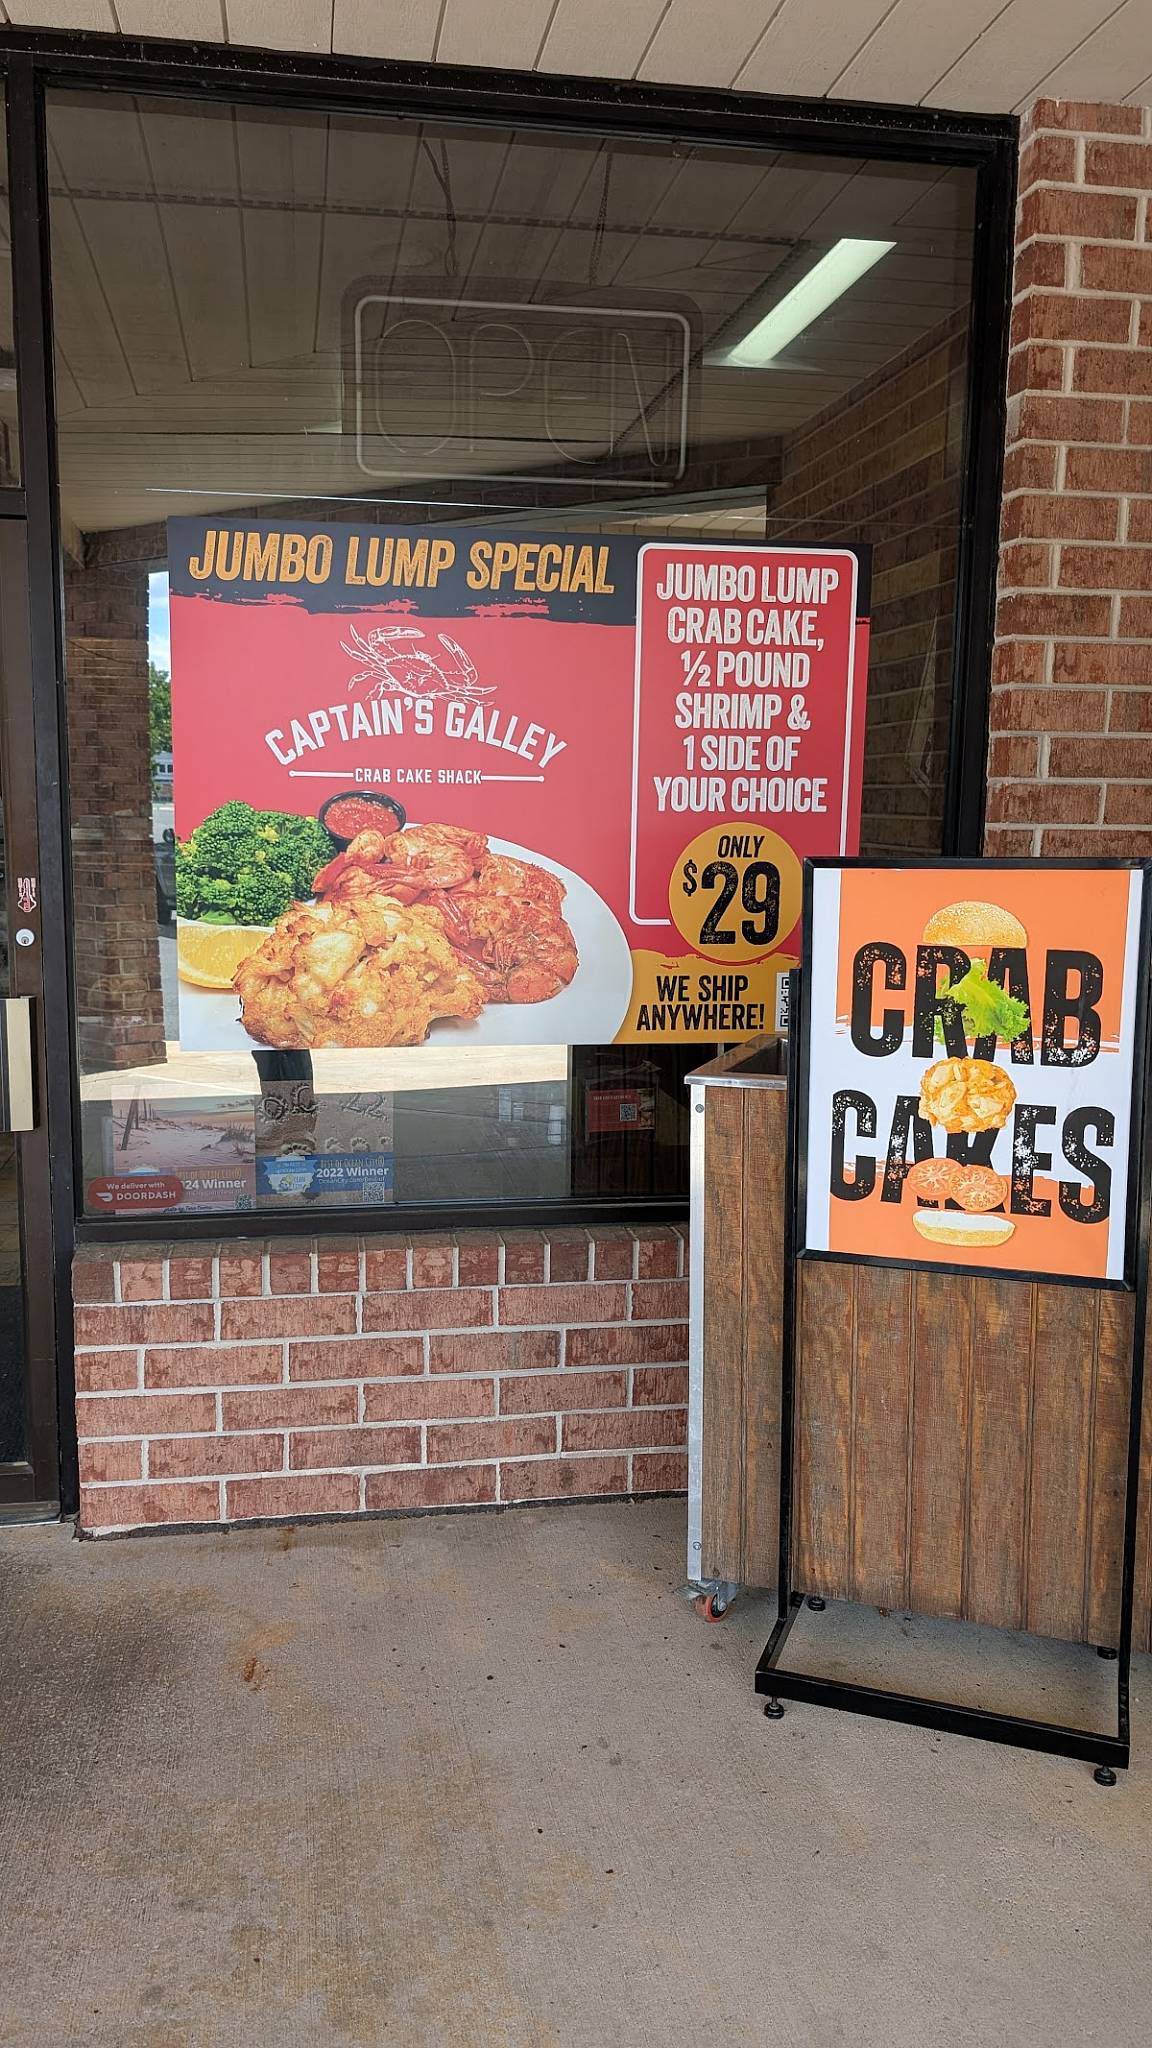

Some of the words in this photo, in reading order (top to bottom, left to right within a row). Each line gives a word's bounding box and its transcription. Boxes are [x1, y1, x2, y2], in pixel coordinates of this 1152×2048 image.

[188, 530, 333, 584] JUMBO
[345, 536, 456, 588] LUMP
[466, 541, 615, 594] SPECIAL
[656, 563, 756, 602] JUMBO
[761, 566, 839, 604] LUMP
[667, 607, 742, 644] CRAB
[746, 608, 825, 652] CAKE,
[716, 651, 811, 688] POUND
[674, 692, 782, 729] SHRIMP
[787, 694, 811, 730] &
[264, 697, 434, 766] CAPTAIN'S
[445, 702, 568, 769] GALLEY
[682, 735, 695, 771] 1
[700, 735, 761, 771] SIDE
[766, 736, 801, 771] OF
[354, 767, 391, 783] CRAB
[397, 768, 432, 784] CAKE
[438, 769, 482, 785] SHACK
[653, 776, 727, 812] YOUR
[731, 777, 828, 813] CHOICE
[717, 835, 765, 858] ONLY
[682, 859, 781, 946] $29
[656, 975, 690, 1002] WE
[698, 975, 749, 1002] SHIP
[850, 941, 1104, 1068] CRAB
[636, 1003, 765, 1031] ANYWHERE!
[120, 1182, 147, 1190] deliver
[201, 1179, 247, 1189] Winner
[316, 1168, 344, 1178] 2022
[346, 1166, 389, 1177] Winner
[117, 1190, 177, 1201] DOORDASH
